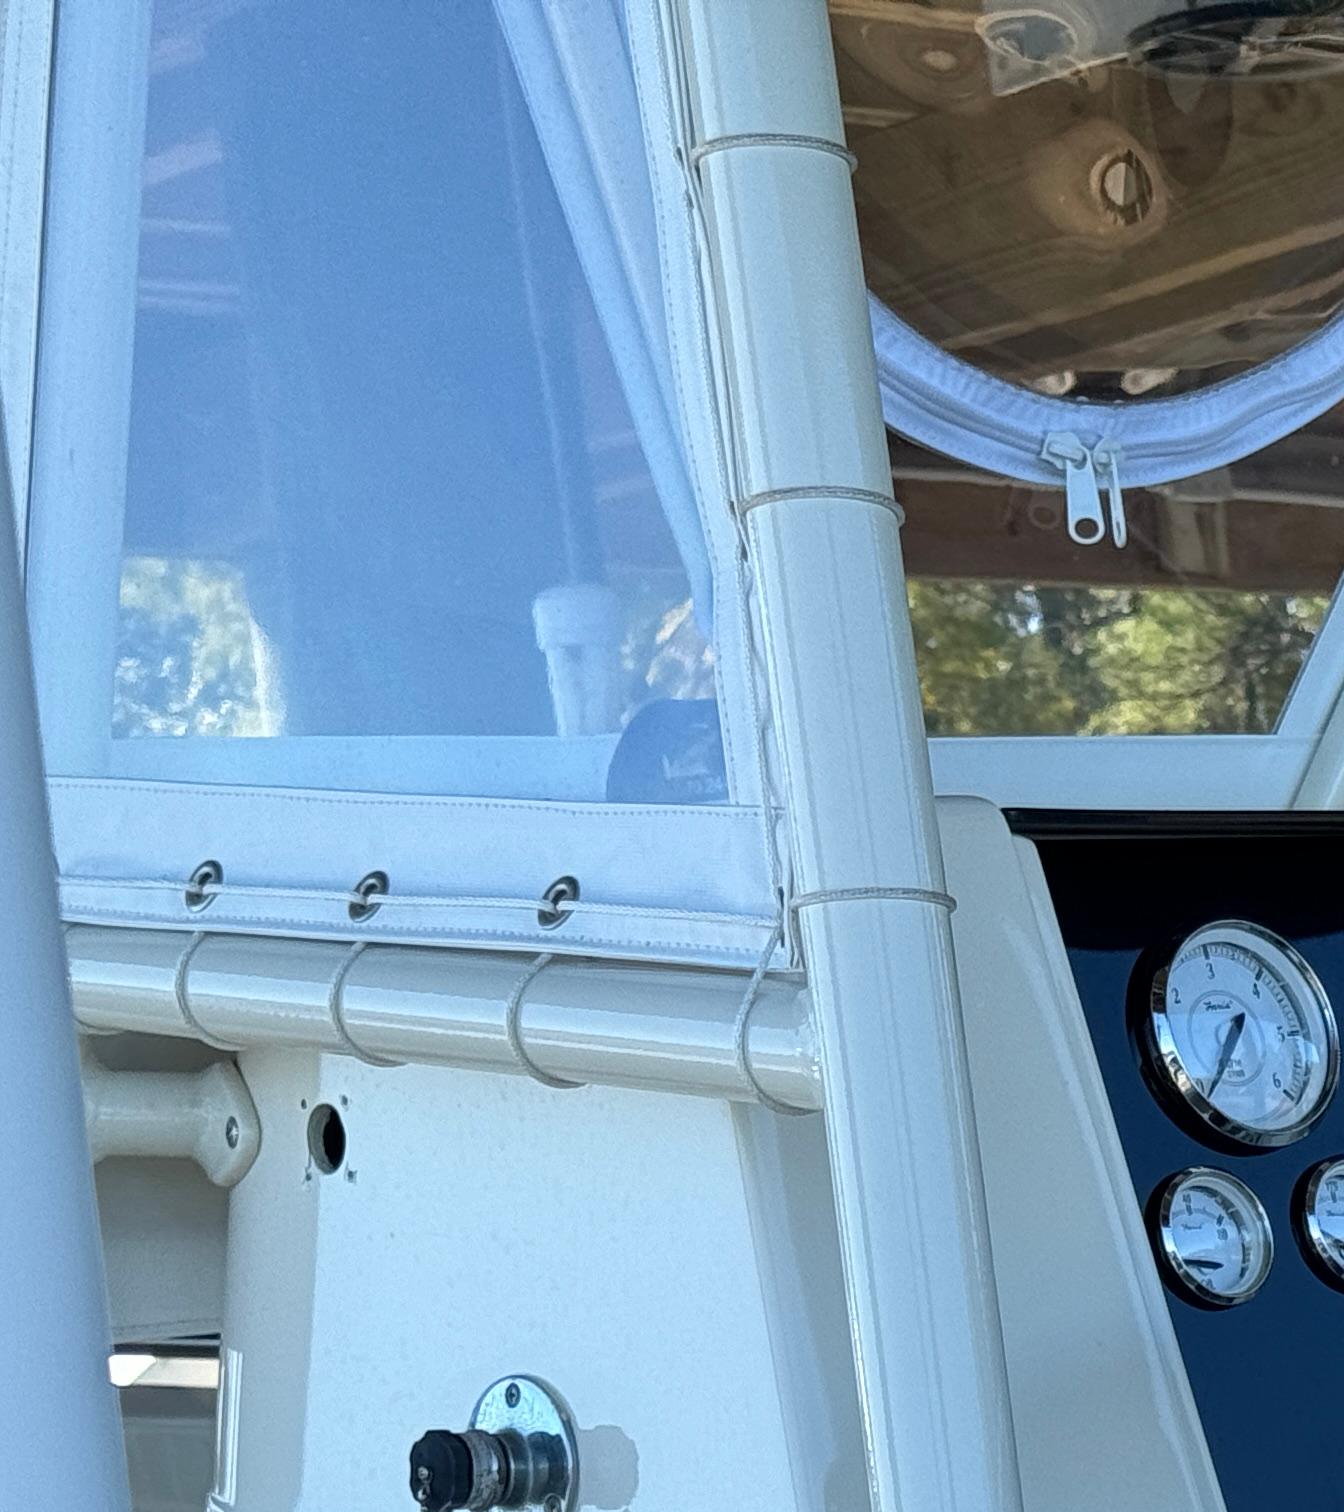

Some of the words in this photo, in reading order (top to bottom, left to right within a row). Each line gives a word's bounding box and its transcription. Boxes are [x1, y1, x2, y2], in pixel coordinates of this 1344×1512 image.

[1205, 962, 1216, 980] 3
[1170, 988, 1182, 1004] 2
[1251, 982, 1261, 999] 4
[1275, 1026, 1286, 1042] 5
[1271, 1072, 1282, 1089] 6
